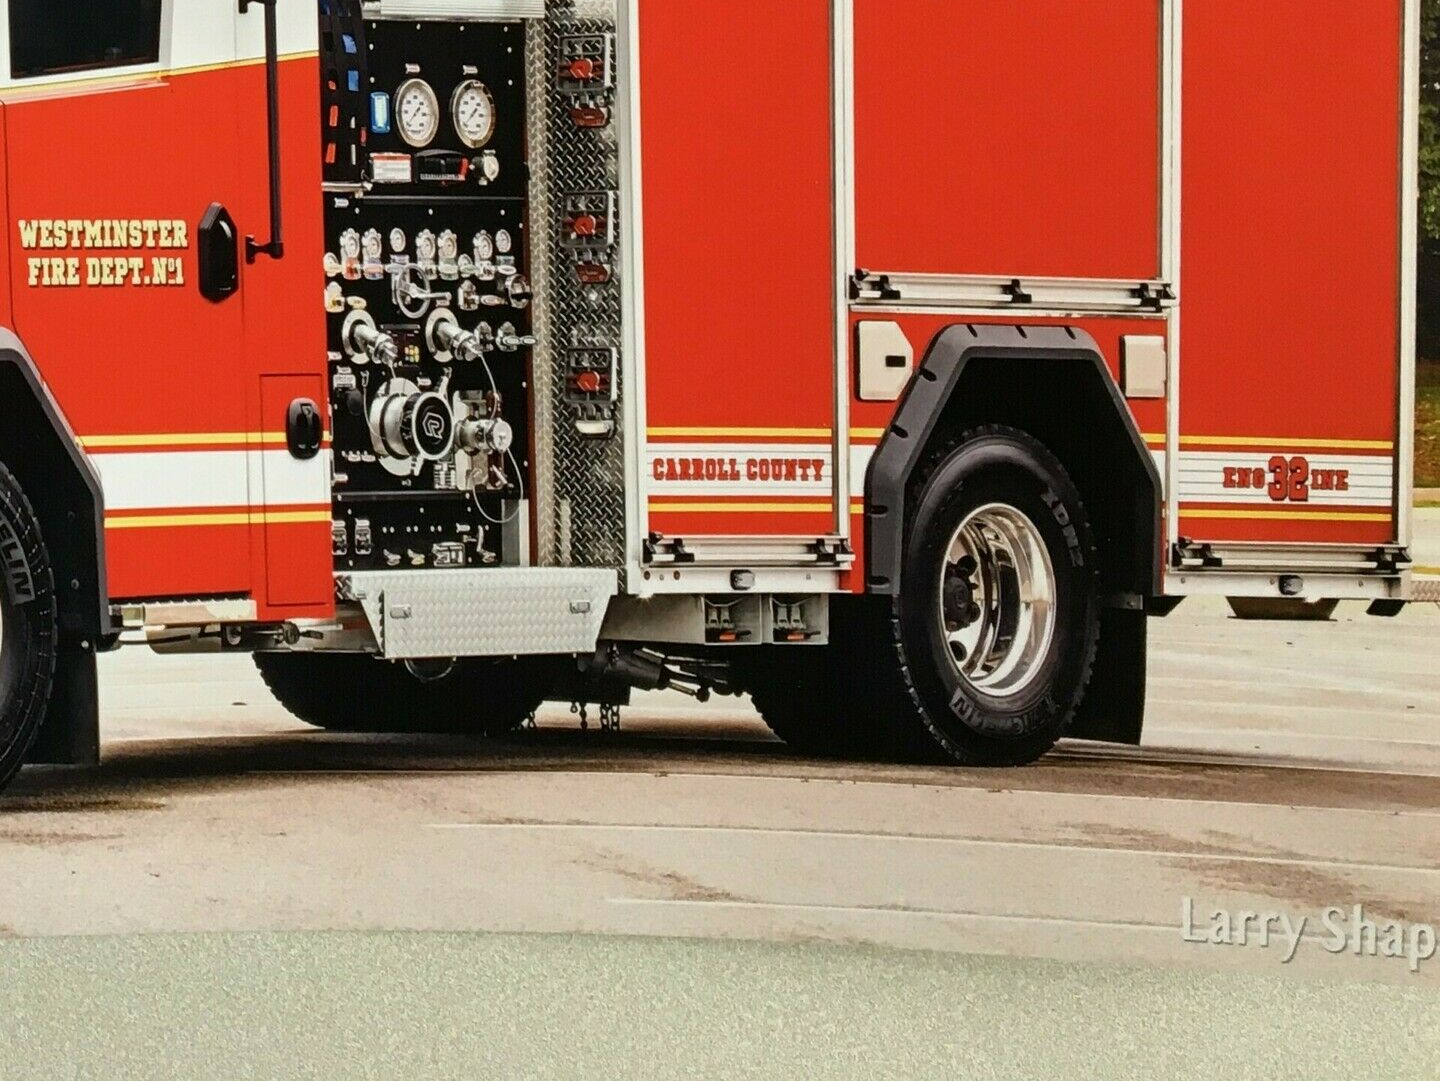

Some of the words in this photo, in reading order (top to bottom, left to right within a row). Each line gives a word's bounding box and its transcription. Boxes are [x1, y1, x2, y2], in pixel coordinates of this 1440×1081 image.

[17, 219, 189, 249] WESTMINSTER
[27, 257, 81, 287] FIRE
[652, 457, 741, 482] CARROLL
[746, 458, 825, 482] COUNTY
[1267, 455, 1309, 502] 32
[1310, 469, 1350, 491] INE
